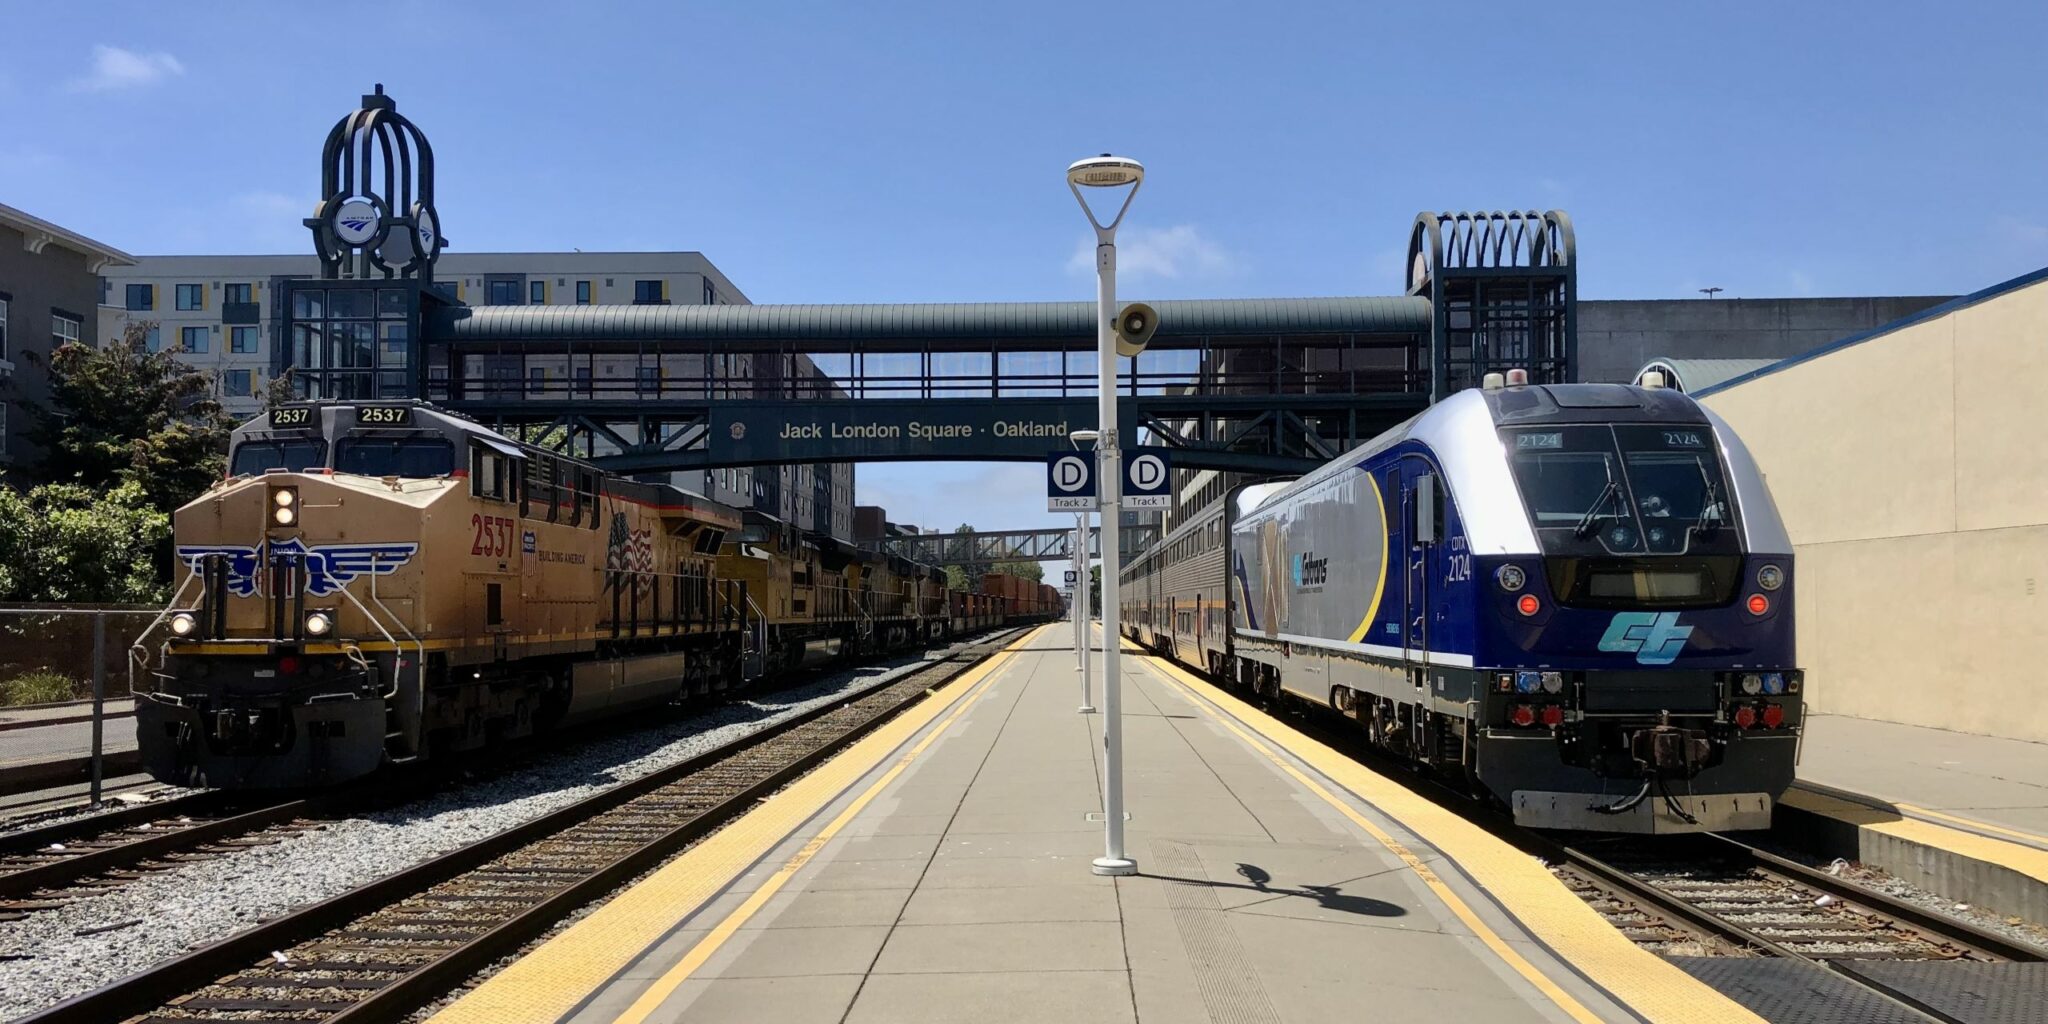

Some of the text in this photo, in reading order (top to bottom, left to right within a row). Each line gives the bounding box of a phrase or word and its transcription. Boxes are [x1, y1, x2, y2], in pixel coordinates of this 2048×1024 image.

[275, 409, 308, 423] 2537
[362, 408, 404, 422] 2537
[780, 423, 822, 438] Jack
[831, 422, 899, 438] London
[908, 422, 972, 441] Square
[993, 421, 1067, 437] Oakland
[1519, 435, 1557, 446] 2124
[1667, 433, 1699, 444] 2124
[1062, 462, 1081, 486] D
[1139, 461, 1159, 484] D
[1054, 498, 1088, 507] Track 2
[1131, 497, 1165, 506] Track 1
[471, 514, 514, 558] 2537
[538, 550, 563, 562] BUILDING
[1449, 554, 1471, 582] 2124
